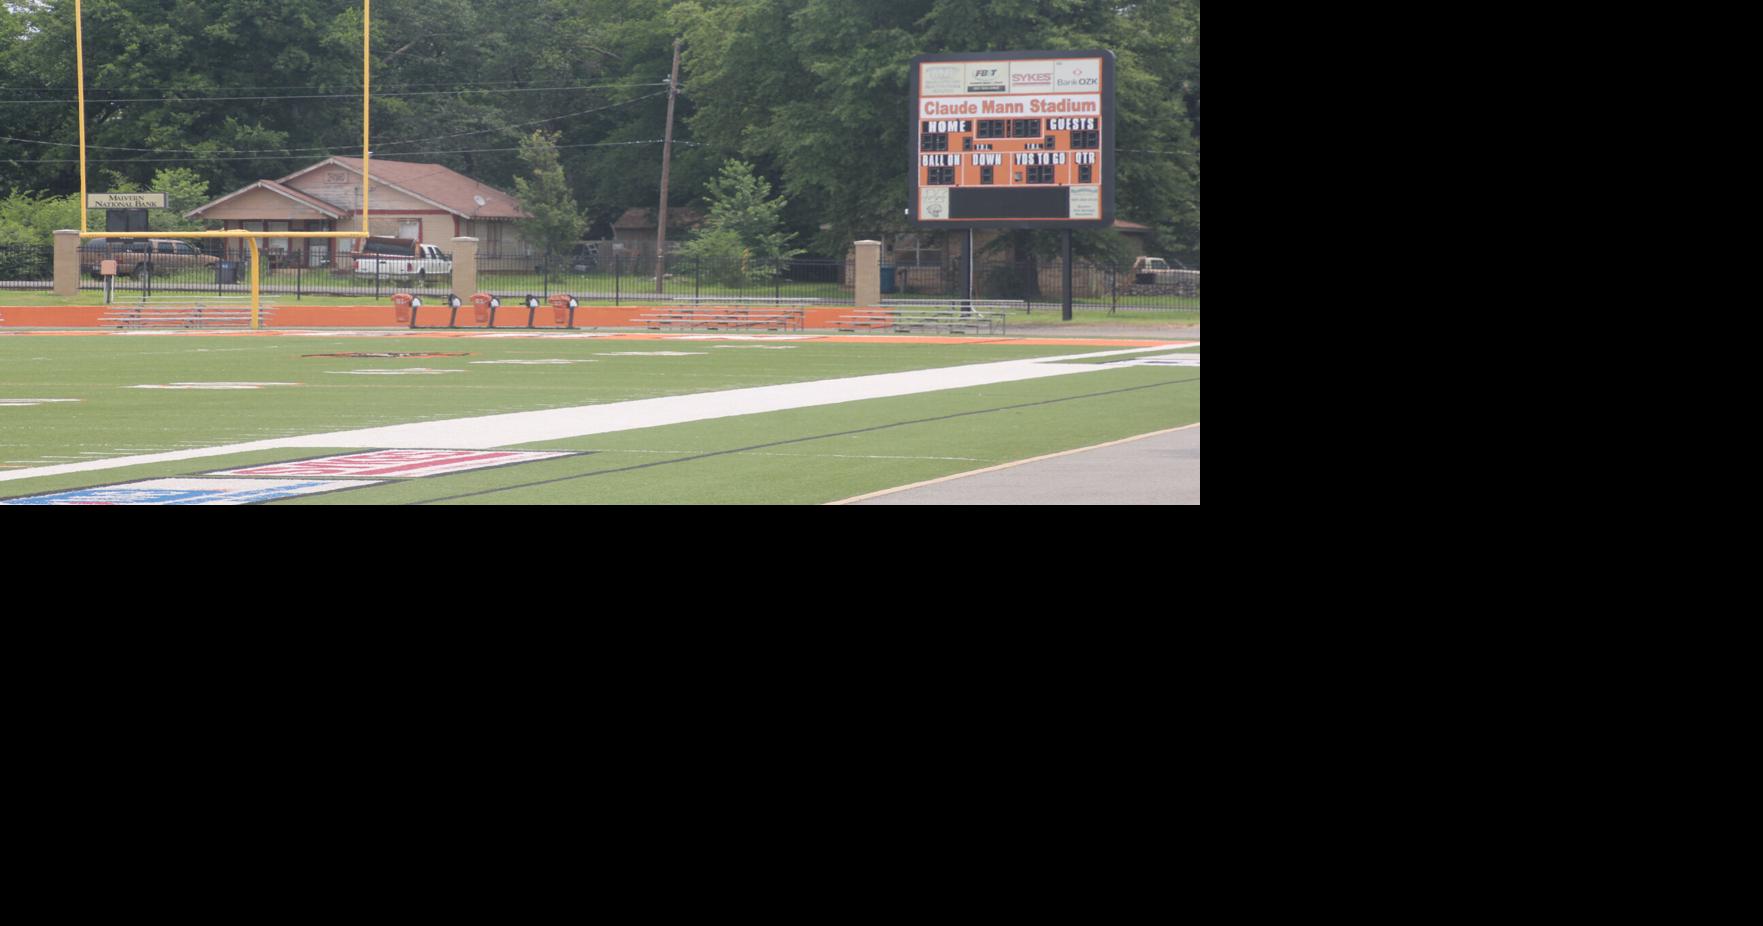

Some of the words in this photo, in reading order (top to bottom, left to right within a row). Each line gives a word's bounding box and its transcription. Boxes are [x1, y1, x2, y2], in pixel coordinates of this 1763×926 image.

[1011, 73, 1051, 82] SYKES
[924, 101, 977, 115] Claude
[982, 99, 1024, 114] Mann
[1030, 98, 1096, 113] Stadium
[928, 120, 966, 133] HOME
[1049, 117, 1094, 130] GUESTS
[922, 154, 944, 167] BALL
[947, 153, 960, 166] ON
[972, 153, 1001, 166] DOWN
[1016, 153, 1034, 166] YDS
[1037, 153, 1049, 165] TO
[1052, 152, 1066, 165] GO
[1075, 152, 1095, 165] QTR
[95, 200, 134, 208] NATIONAL
[135, 200, 157, 208] BANK
